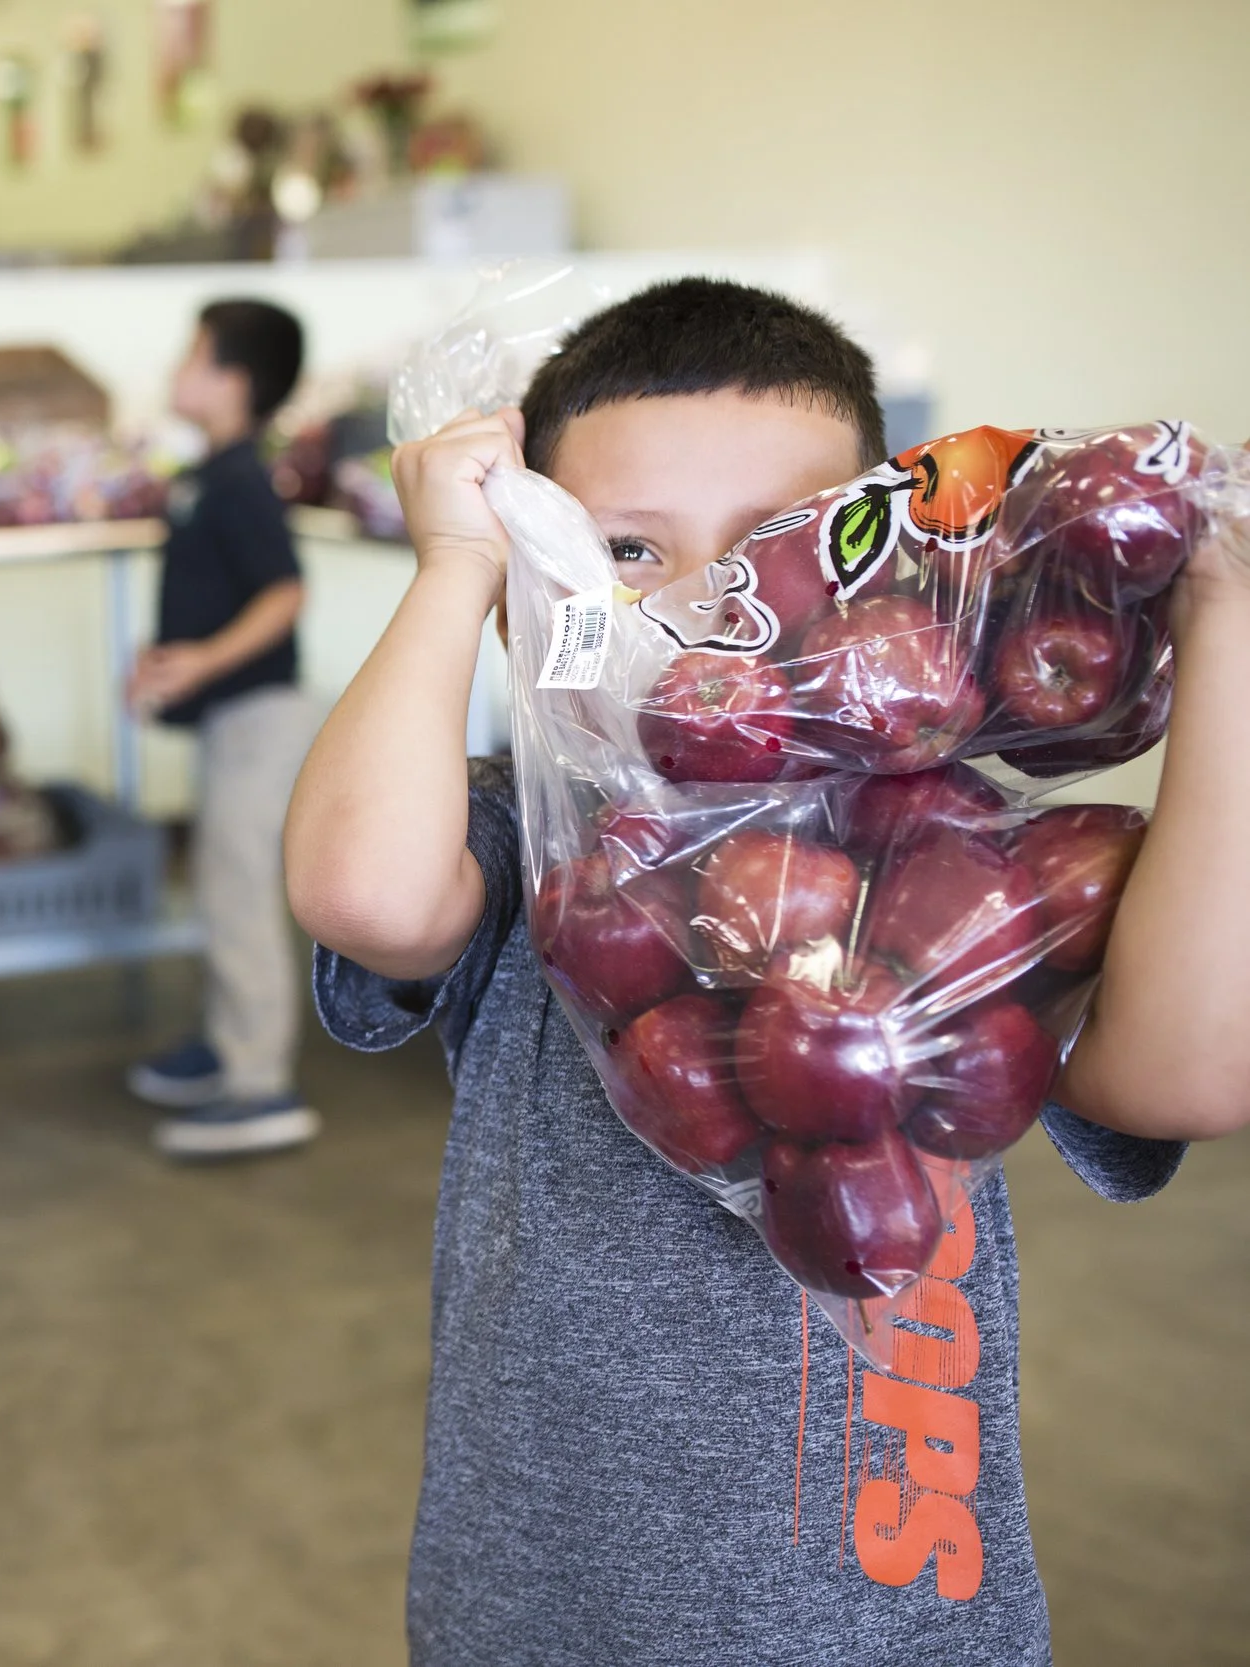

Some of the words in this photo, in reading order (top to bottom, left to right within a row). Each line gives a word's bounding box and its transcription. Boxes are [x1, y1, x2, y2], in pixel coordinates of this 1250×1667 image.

[550, 666, 559, 681] RED
[556, 604, 570, 663] DELICIOUS
[576, 612, 584, 641] FANCY
